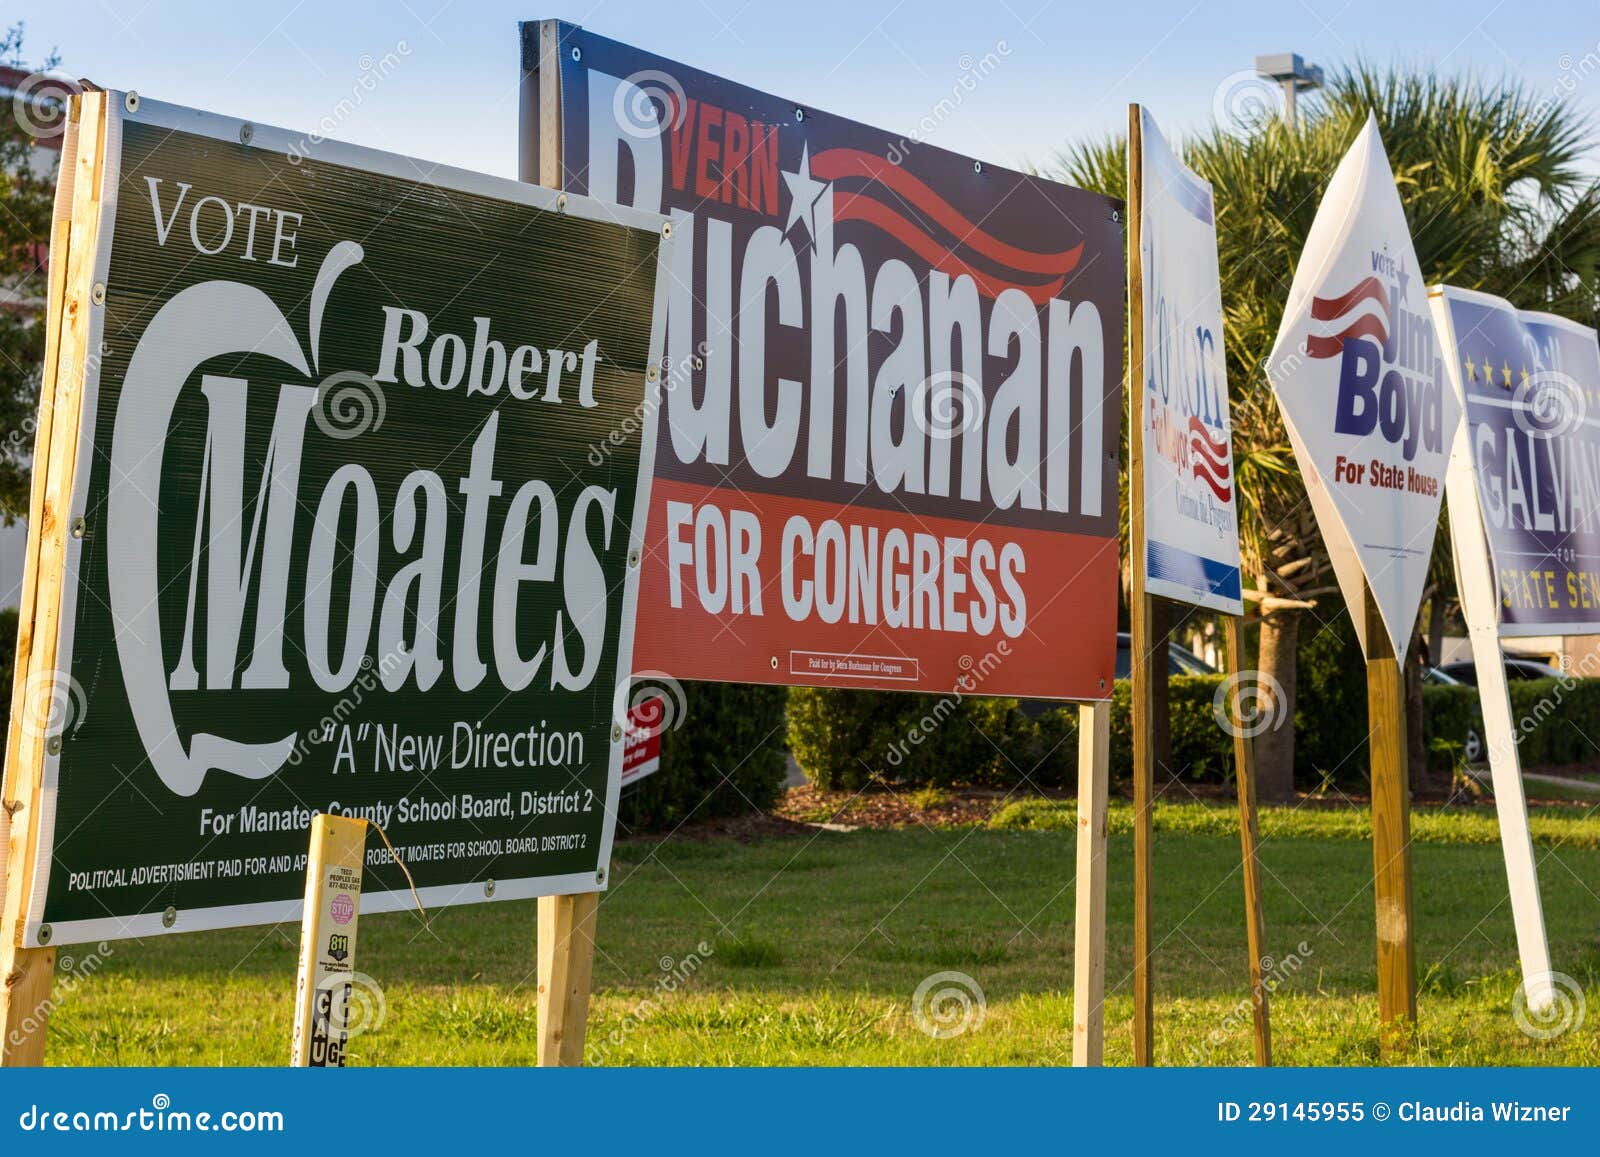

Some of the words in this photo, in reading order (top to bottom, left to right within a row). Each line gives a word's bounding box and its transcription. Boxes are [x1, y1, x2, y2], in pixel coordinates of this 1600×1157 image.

[669, 91, 779, 217] VERN
[143, 175, 303, 268] VOTE
[1371, 251, 1396, 279] VOTE
[372, 305, 603, 408] Robert
[1383, 286, 1433, 377] Jim
[1334, 336, 1443, 462] Boyd
[1334, 455, 1365, 486] For
[1369, 459, 1404, 491] State
[1407, 468, 1438, 498] House
[169, 374, 618, 693] Moates
[666, 499, 764, 617] FOR
[781, 514, 1027, 639] CONGRESS
[1500, 567, 1560, 609] STATE
[808, 657, 820, 669] Paid
[374, 723, 443, 772] New
[451, 720, 585, 769] Direction
[200, 808, 237, 836] For
[396, 795, 456, 823] School
[461, 792, 515, 820] Board,
[520, 789, 580, 816] District
[583, 788, 593, 812] 2
[68, 868, 128, 891] POLITICAL
[129, 861, 216, 887] ADVERTISMENT
[217, 859, 241, 878] PAID
[244, 857, 267, 876] FOR
[268, 855, 292, 873] AND
[366, 845, 406, 866] ROBERT
[407, 843, 446, 862] MOATES
[447, 841, 466, 859] FOR
[467, 839, 505, 857] SCHOOL
[505, 836, 539, 854] BOARD,
[541, 834, 577, 851] DISTRICT
[577, 833, 586, 849] 2
[331, 903, 353, 916] STOP
[330, 935, 347, 952] 811
